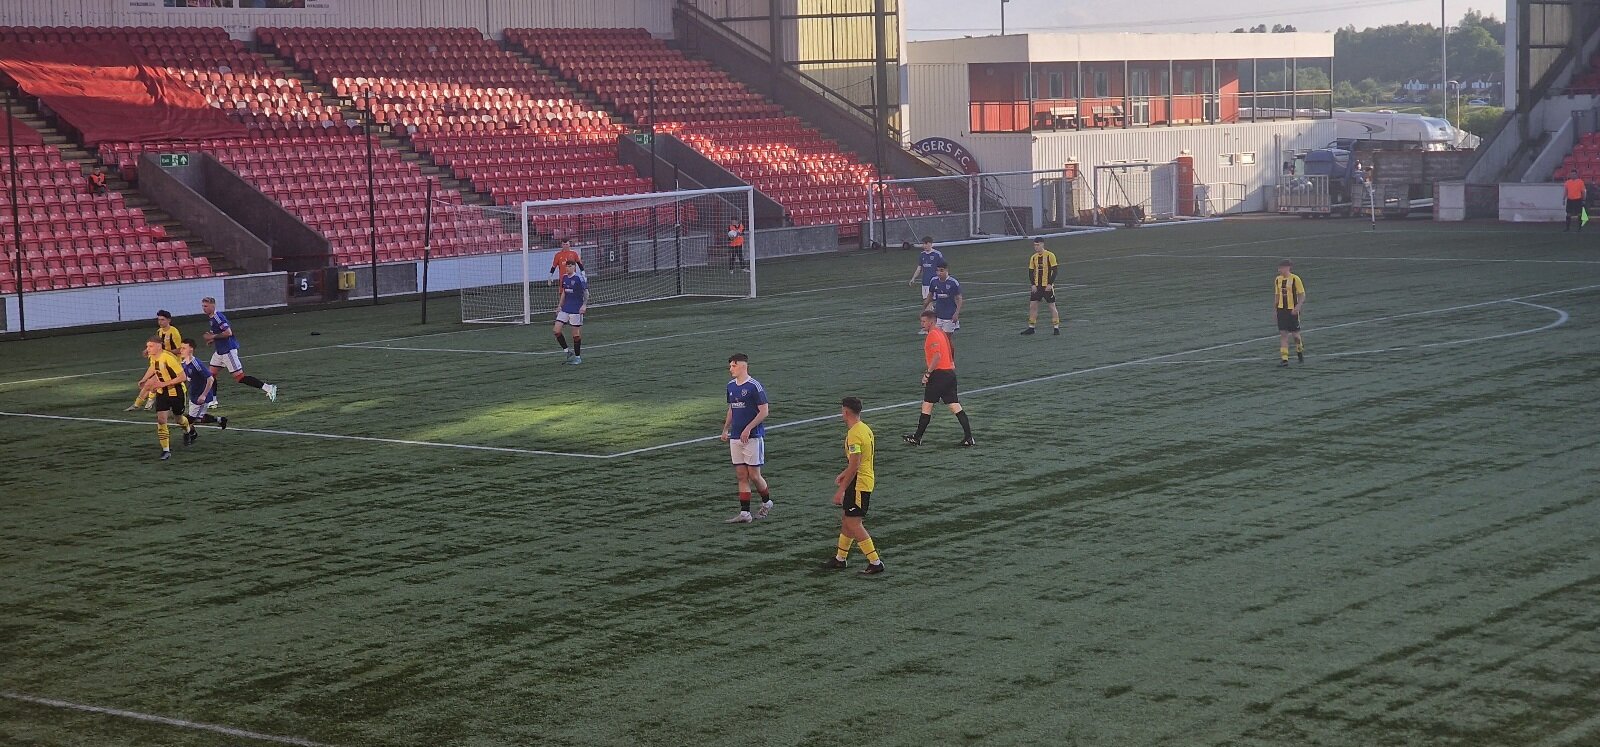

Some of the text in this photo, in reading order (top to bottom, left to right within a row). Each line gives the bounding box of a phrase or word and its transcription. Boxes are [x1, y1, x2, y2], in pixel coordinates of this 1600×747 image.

[954, 148, 970, 170] F.C.
[609, 250, 615, 262] 6
[301, 278, 308, 291] 5
